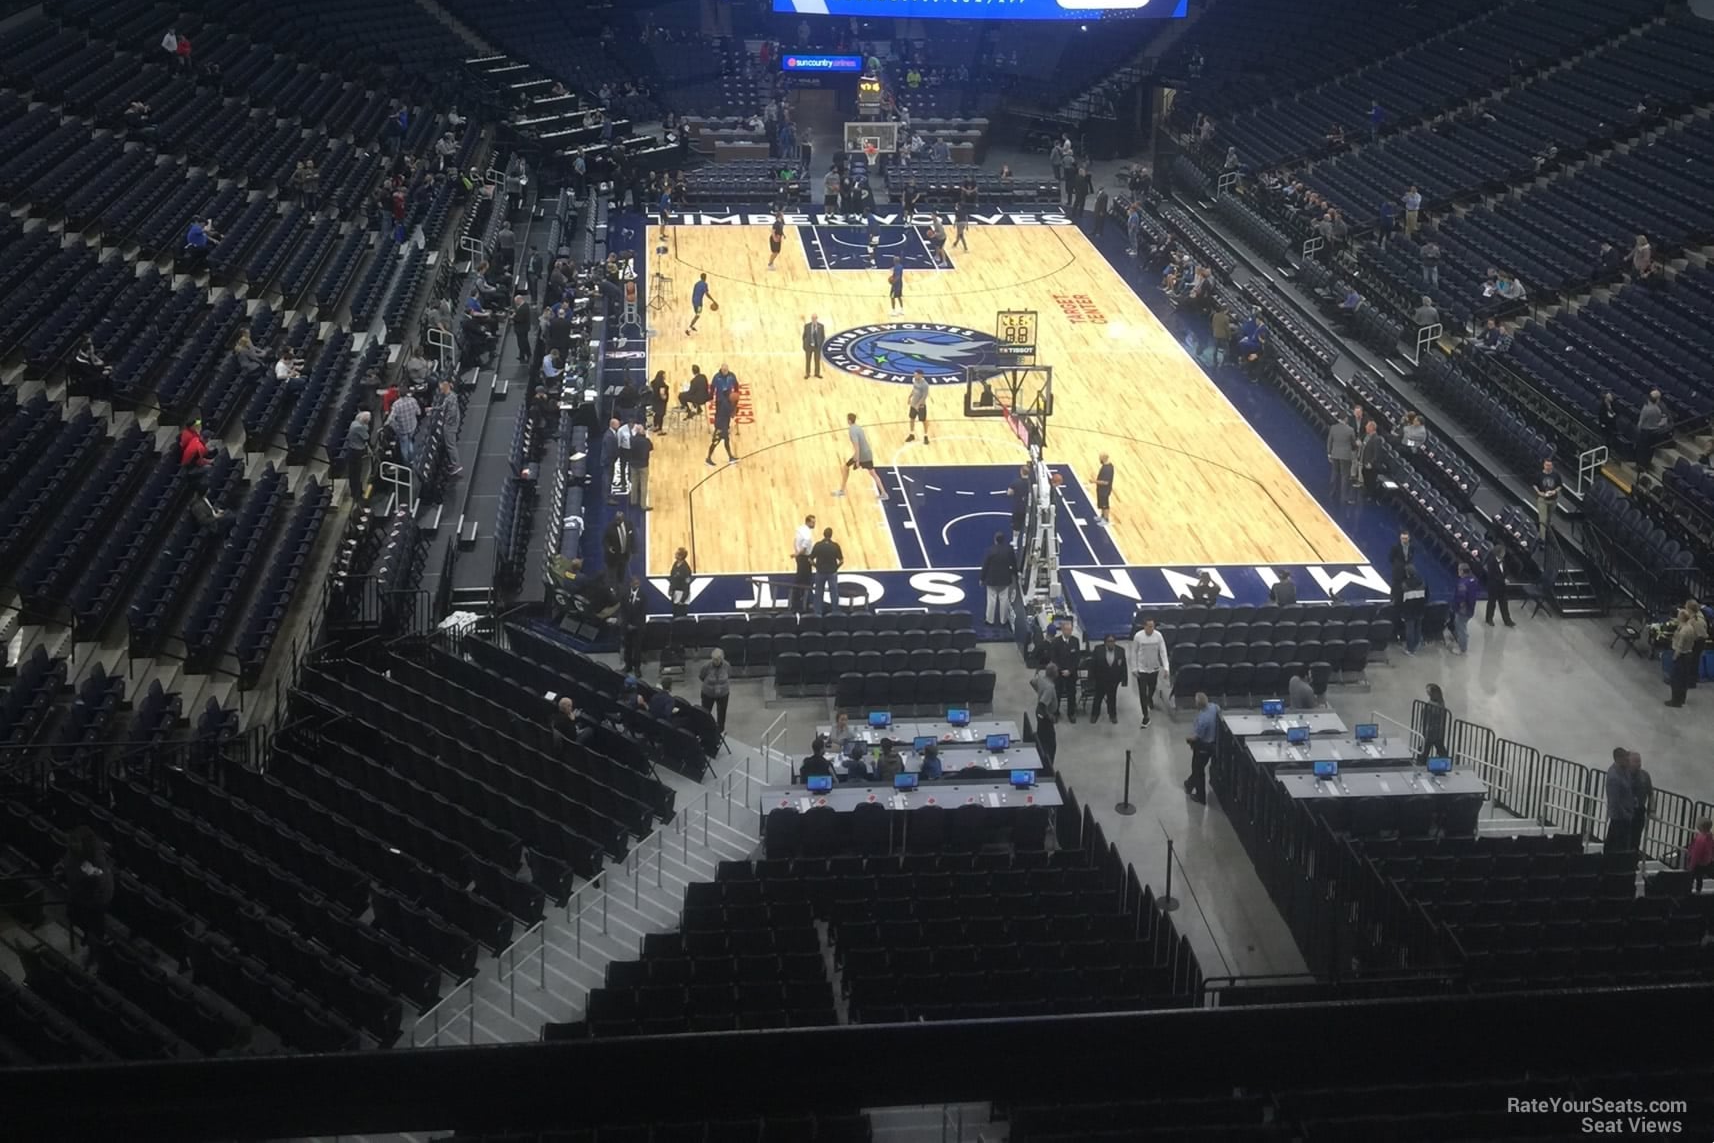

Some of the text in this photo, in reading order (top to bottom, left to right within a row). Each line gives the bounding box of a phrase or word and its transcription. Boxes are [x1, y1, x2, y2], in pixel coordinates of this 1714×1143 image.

[827, 323, 975, 352] TIMBERWOLVES
[831, 354, 960, 384] MINESOTA
[648, 565, 1392, 609] MINNSOTA
